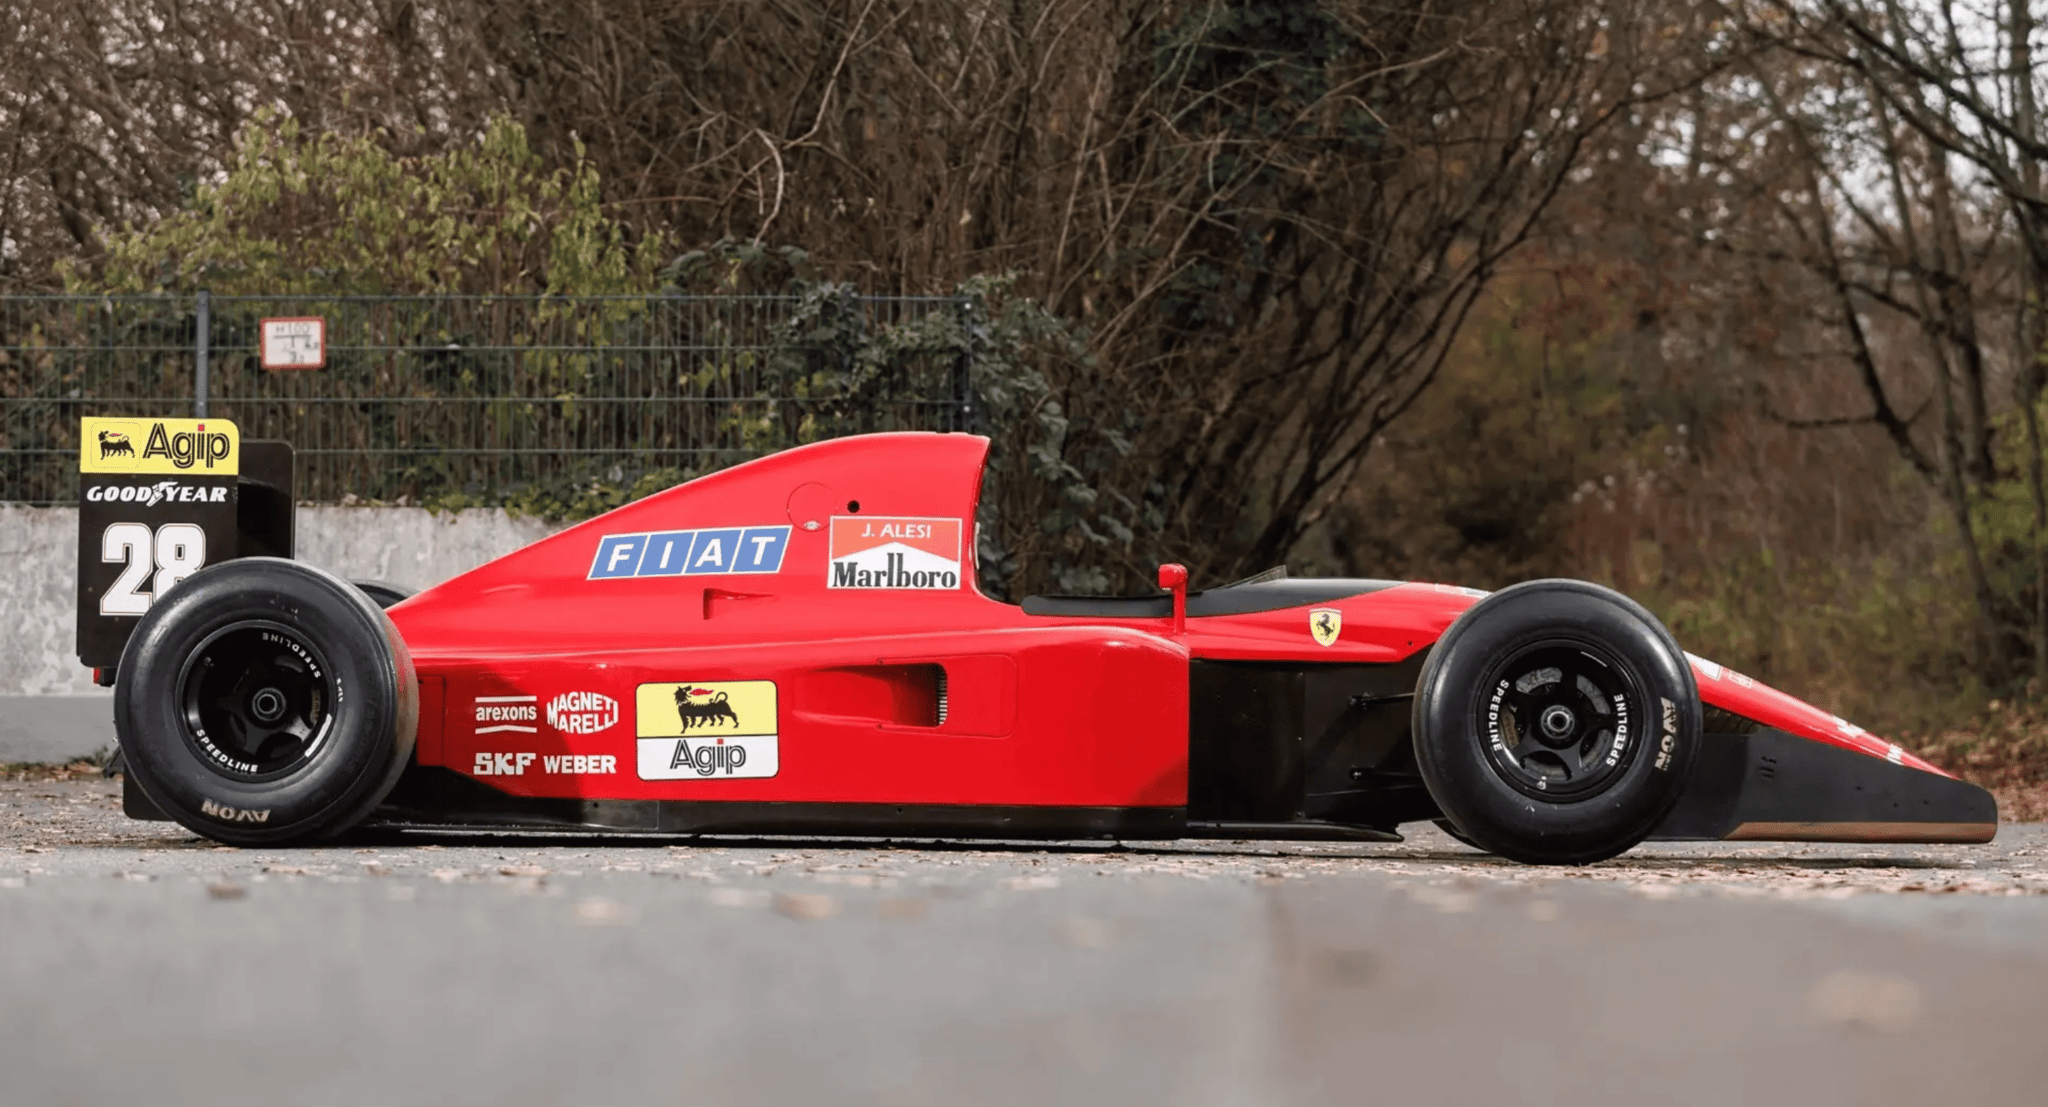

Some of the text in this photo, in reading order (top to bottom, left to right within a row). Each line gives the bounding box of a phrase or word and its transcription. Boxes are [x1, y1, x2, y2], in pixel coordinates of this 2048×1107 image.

[142, 422, 230, 469] Agip
[86, 481, 228, 507] GOODYEAR
[861, 524, 932, 539] J. ALESI
[99, 521, 206, 616] 28
[607, 535, 777, 572] FIAT
[832, 552, 956, 588] Marlboro
[261, 631, 322, 680] SPEEDLINE
[475, 702, 537, 722] arexons
[546, 691, 619, 717] MAGNETI
[546, 708, 619, 735] MARELLI
[1488, 678, 1511, 753] SPEEDLINE
[1606, 693, 1629, 767] SPEEDLINE
[1655, 697, 1677, 772] AVON
[195, 728, 260, 774] SPEEDLINE
[473, 752, 537, 776] SKF
[543, 754, 617, 774] WEBER
[669, 738, 747, 776] Agip
[201, 798, 272, 823] AVON
